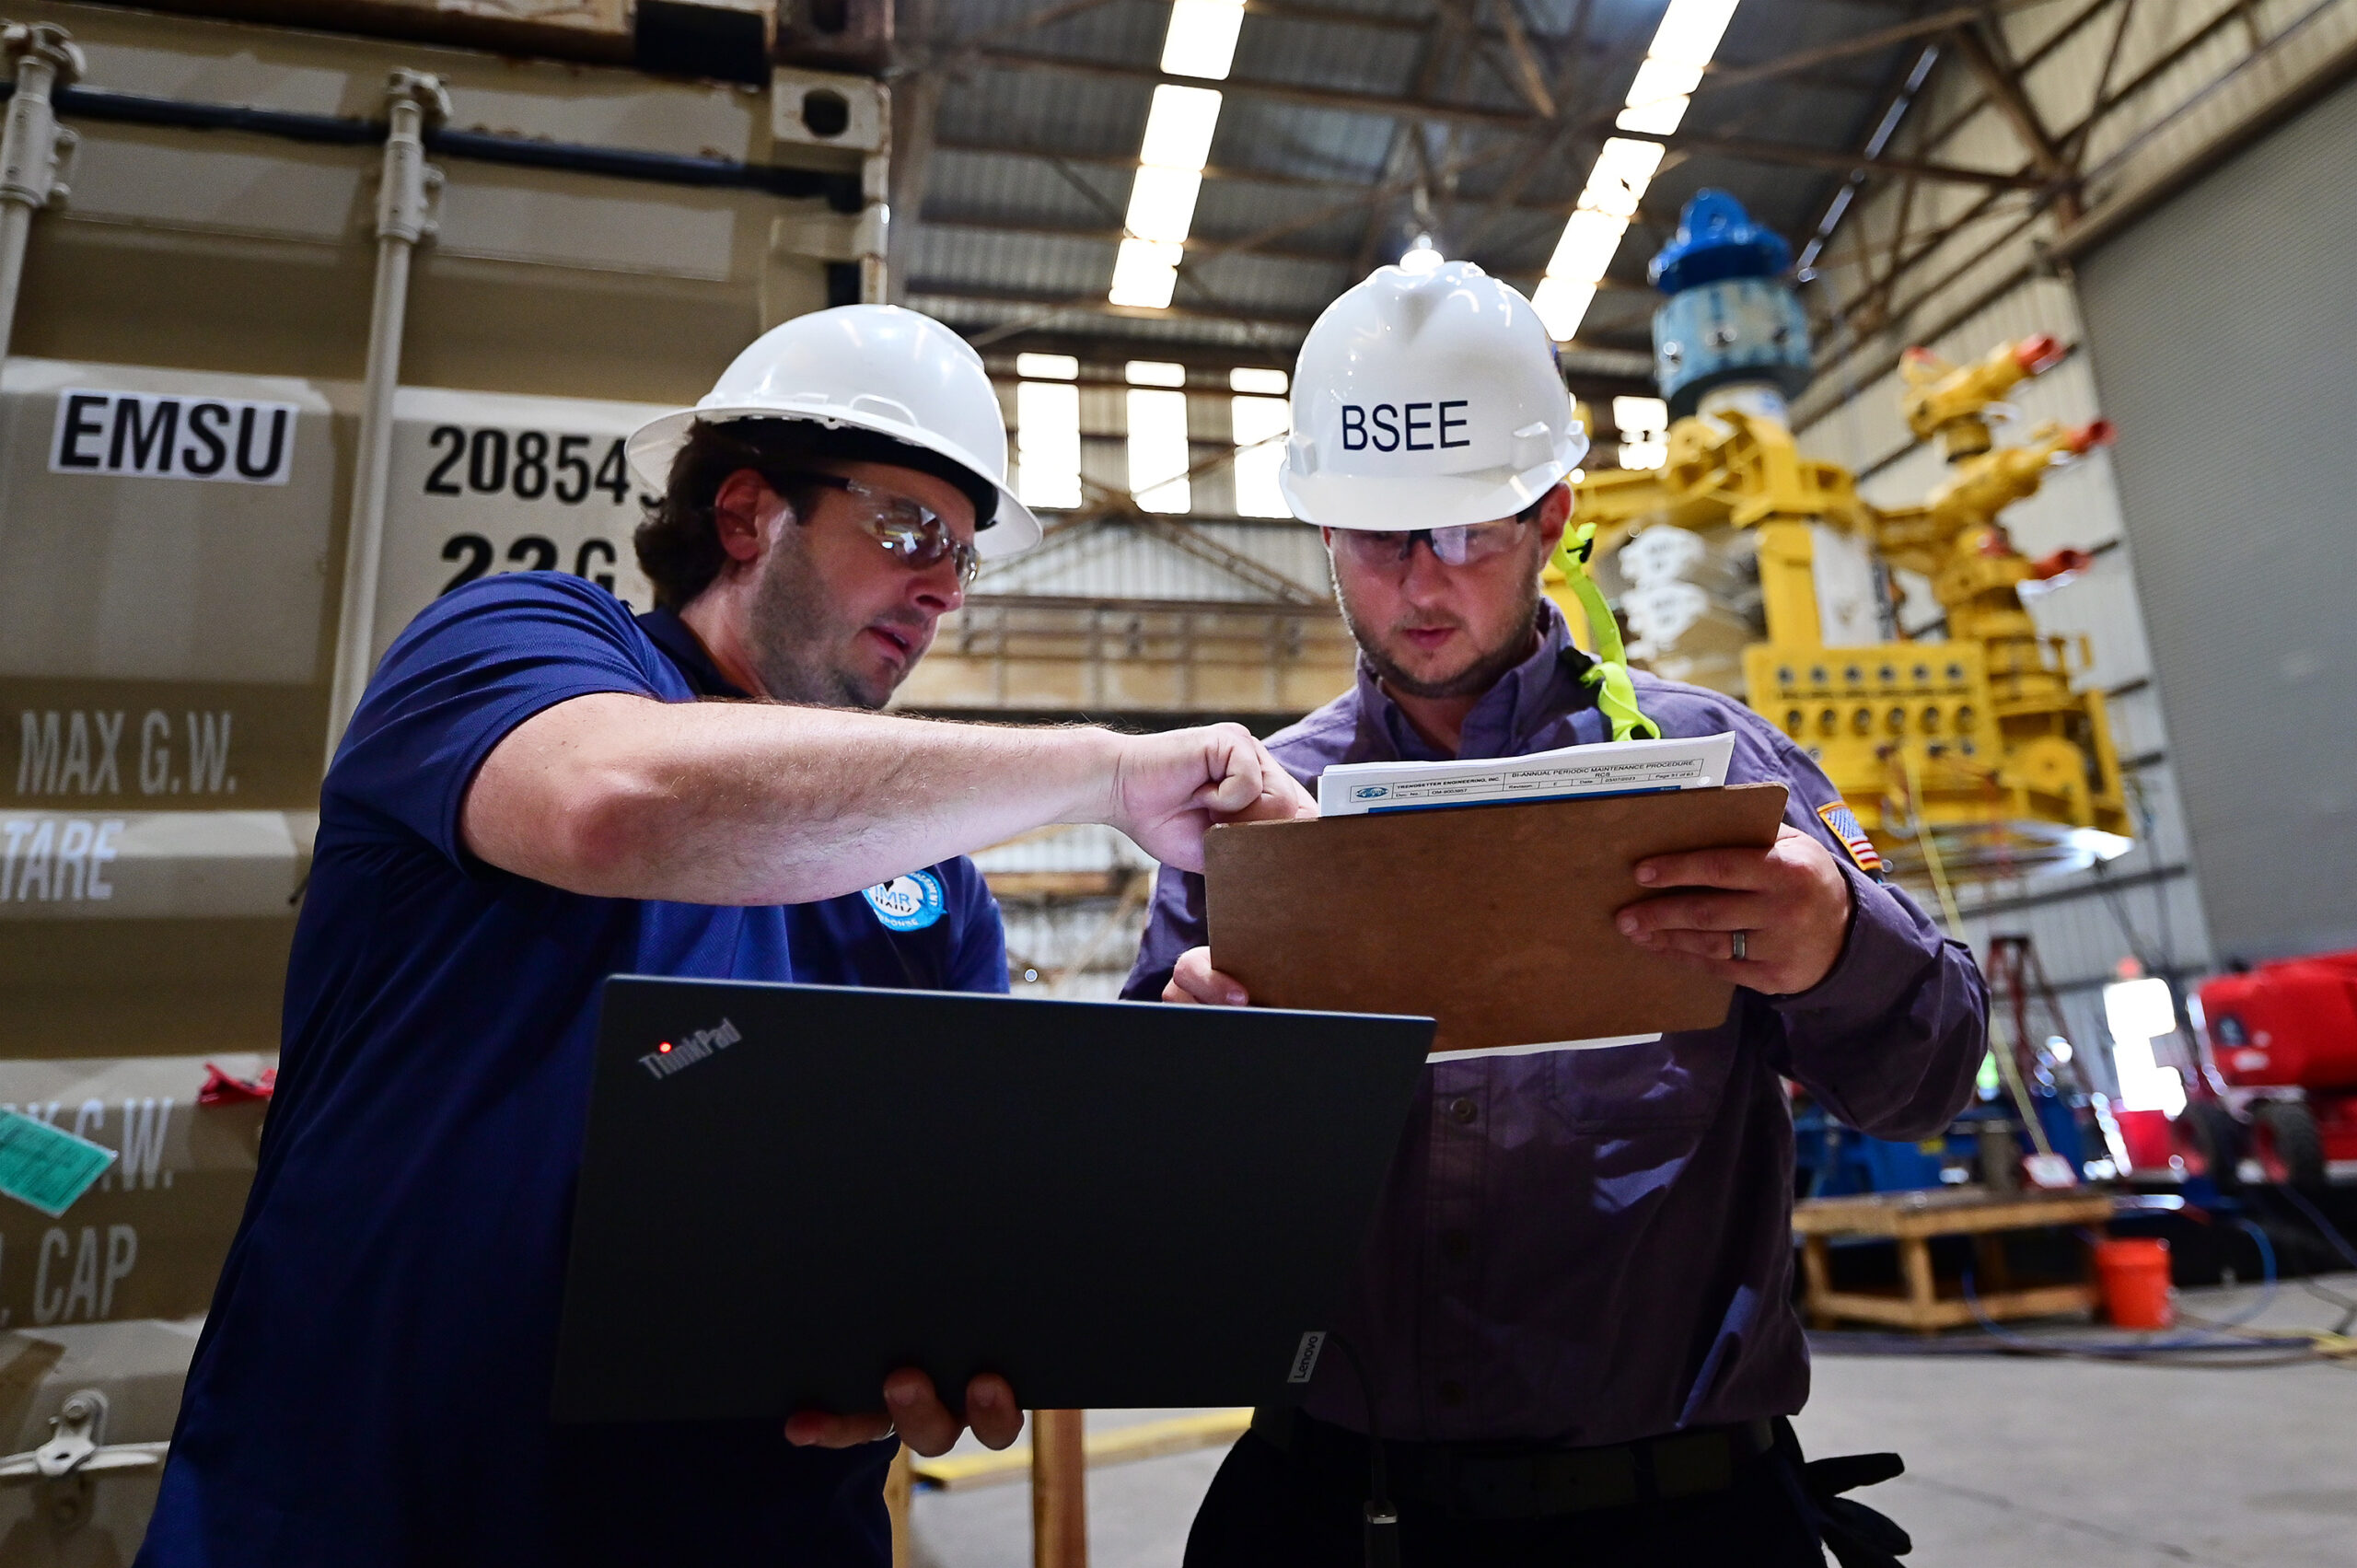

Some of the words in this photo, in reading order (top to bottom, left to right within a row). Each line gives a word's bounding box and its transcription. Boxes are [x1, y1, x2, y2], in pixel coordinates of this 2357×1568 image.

[59, 395, 287, 479] EMSU
[424, 425, 665, 507] 20854
[1341, 400, 1470, 452] BSEE
[17, 711, 124, 795] MAX
[141, 710, 237, 796] G.W.
[1553, 767, 1589, 775] PERIODIC
[1590, 763, 1644, 772] MAINTENANCE
[0, 820, 125, 902] TARE
[638, 1016, 742, 1079] ThinkPad
[33, 1223, 137, 1324] CAP
[1294, 1336, 1318, 1378] Lenovo
